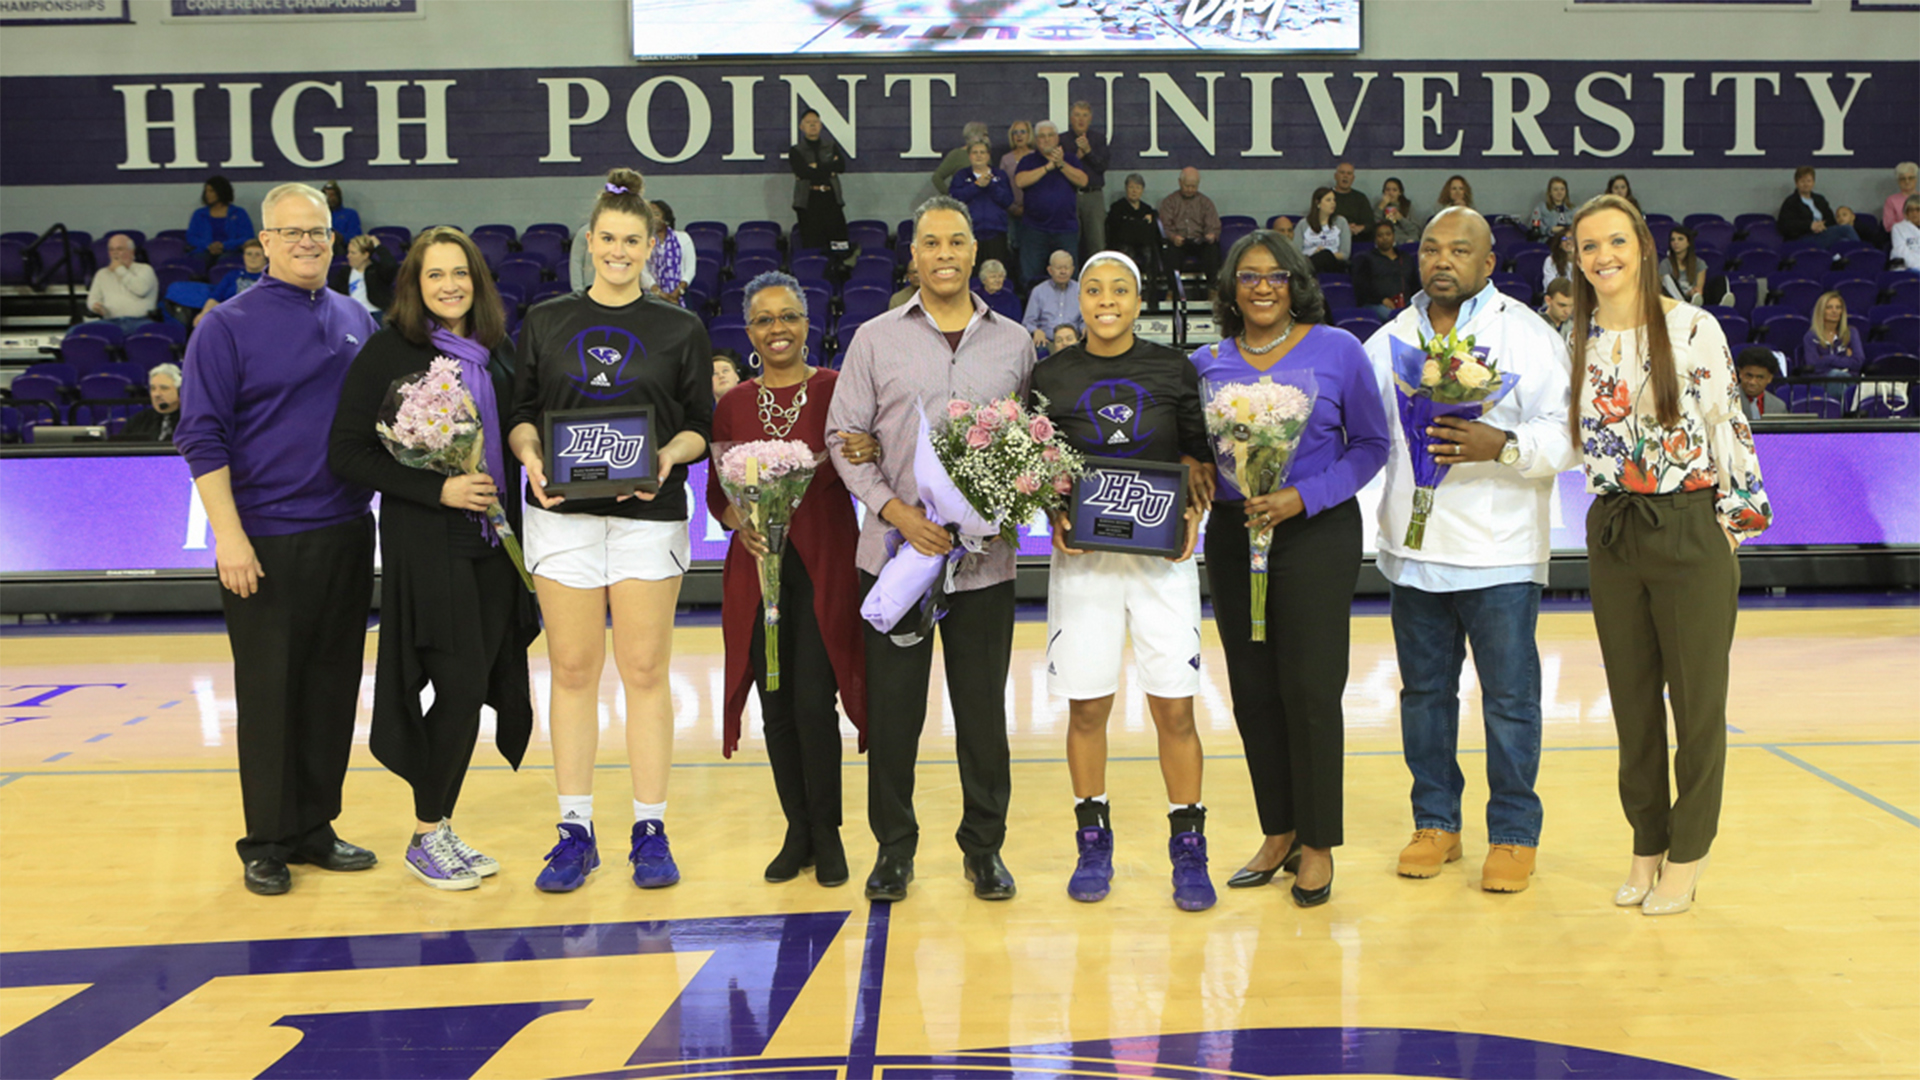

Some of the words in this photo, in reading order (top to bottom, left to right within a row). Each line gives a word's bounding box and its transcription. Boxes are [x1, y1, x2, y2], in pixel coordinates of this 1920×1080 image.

[185, 0, 282, 10] CONFERENCE
[285, 0, 401, 8] CHAMPIONSHIPS
[113, 80, 459, 170] HIGH
[537, 73, 957, 164] POINT
[1037, 71, 1872, 157] UNIVERSITY
[557, 422, 645, 469] HPU
[1082, 468, 1175, 528] HPU
